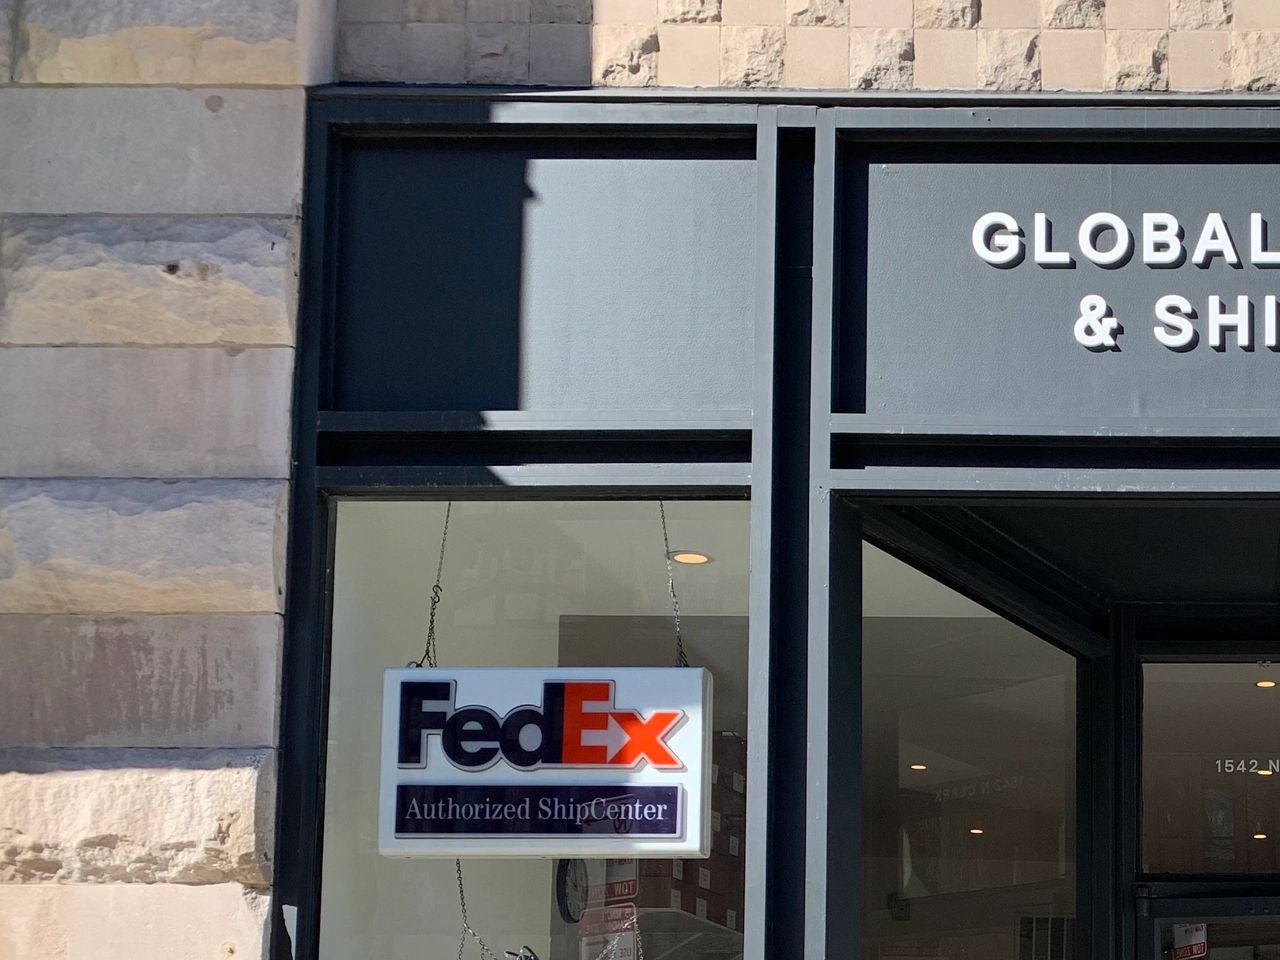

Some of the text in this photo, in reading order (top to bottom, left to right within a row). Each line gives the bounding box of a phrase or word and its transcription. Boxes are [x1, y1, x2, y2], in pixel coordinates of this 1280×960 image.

[1073, 294, 1120, 348] &
[398, 681, 681, 767] FedEx
[1215, 759, 1259, 773] 1542
[1268, 759, 1280, 773] N
[405, 797, 668, 825] Authorized ShipCenter
